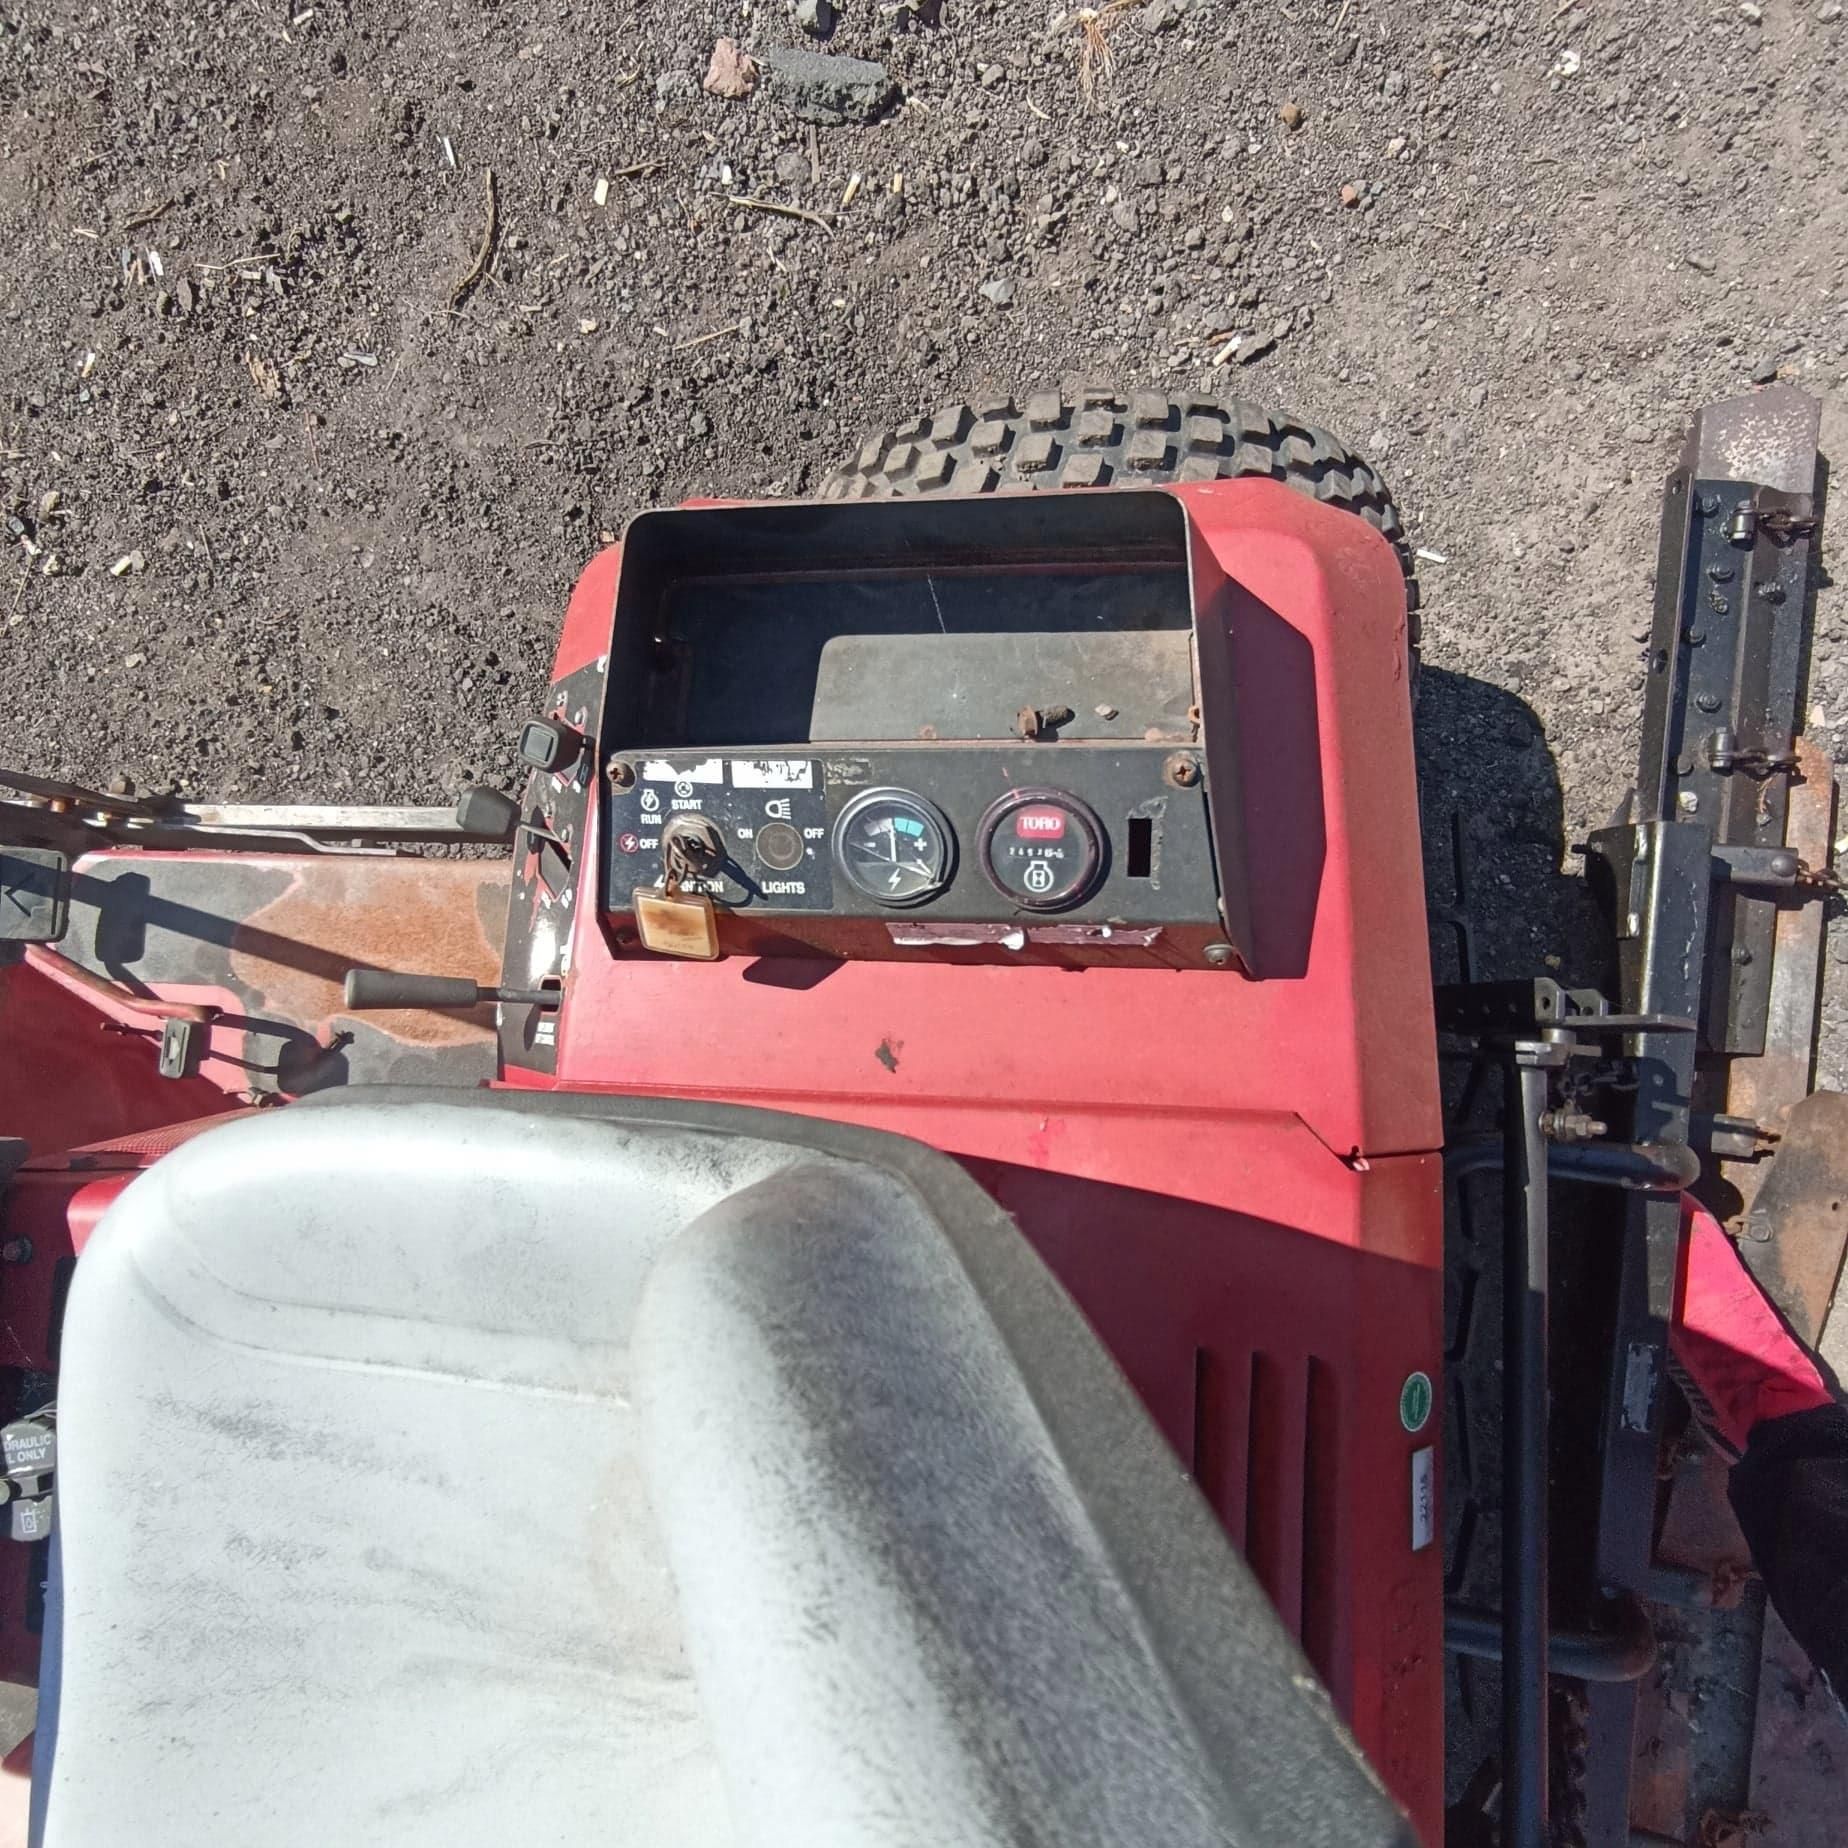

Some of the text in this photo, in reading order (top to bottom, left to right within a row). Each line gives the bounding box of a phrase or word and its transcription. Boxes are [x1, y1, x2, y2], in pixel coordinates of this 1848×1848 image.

[671, 799, 703, 810] START
[640, 813, 663, 825] RUN
[1019, 815, 1062, 831] TORO
[737, 828, 753, 839] ON
[803, 827, 825, 839] OFF
[639, 838, 659, 850] OFF
[761, 881, 806, 895] LIGHTS
[17, 1448, 46, 1462] ONLY
